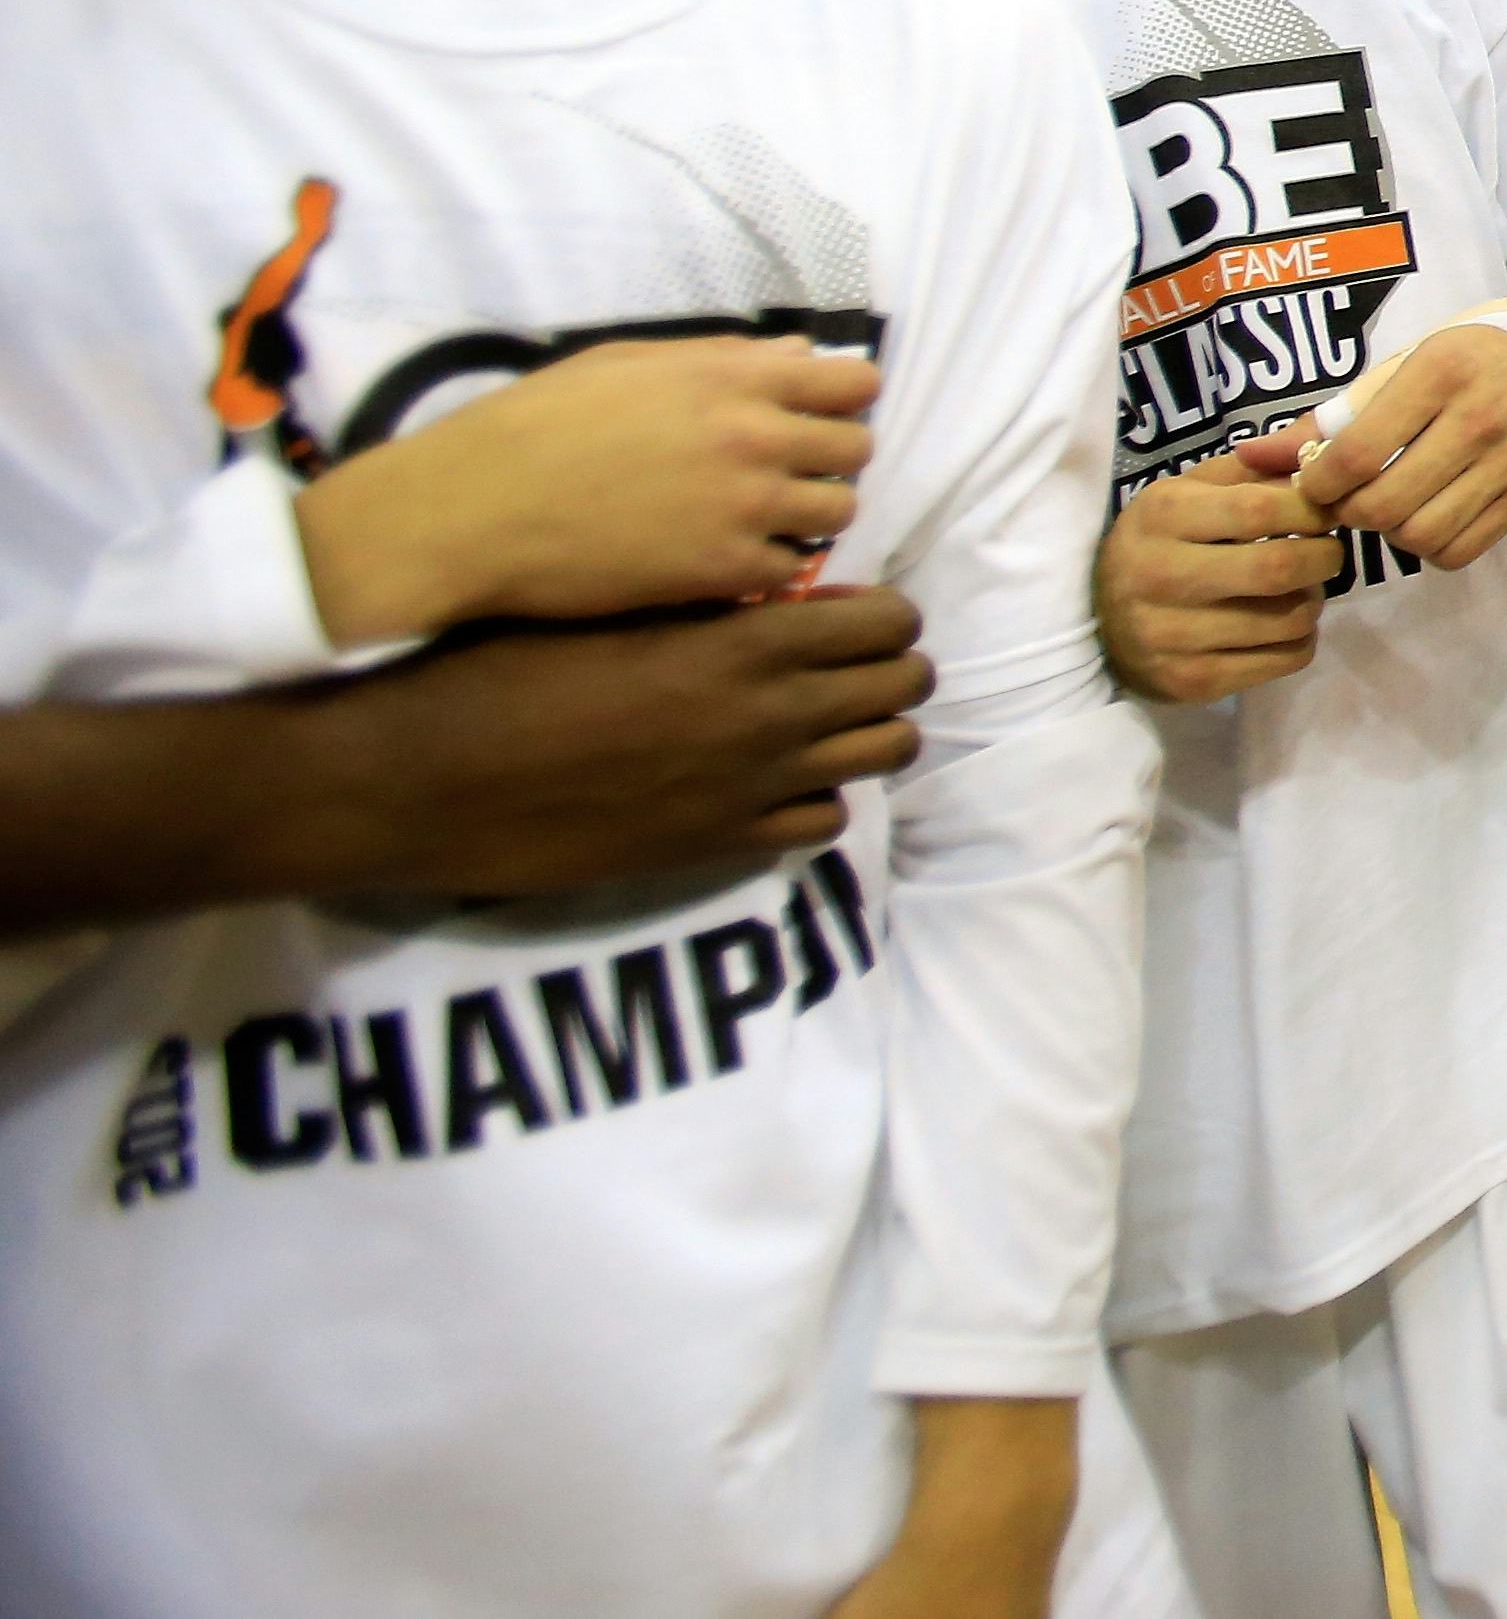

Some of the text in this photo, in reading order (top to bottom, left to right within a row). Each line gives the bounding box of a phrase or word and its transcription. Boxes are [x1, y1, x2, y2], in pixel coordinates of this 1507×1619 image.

[1117, 81, 1363, 274] BE
[1120, 278, 1200, 335] ALL
[1218, 237, 1331, 291] FAME
